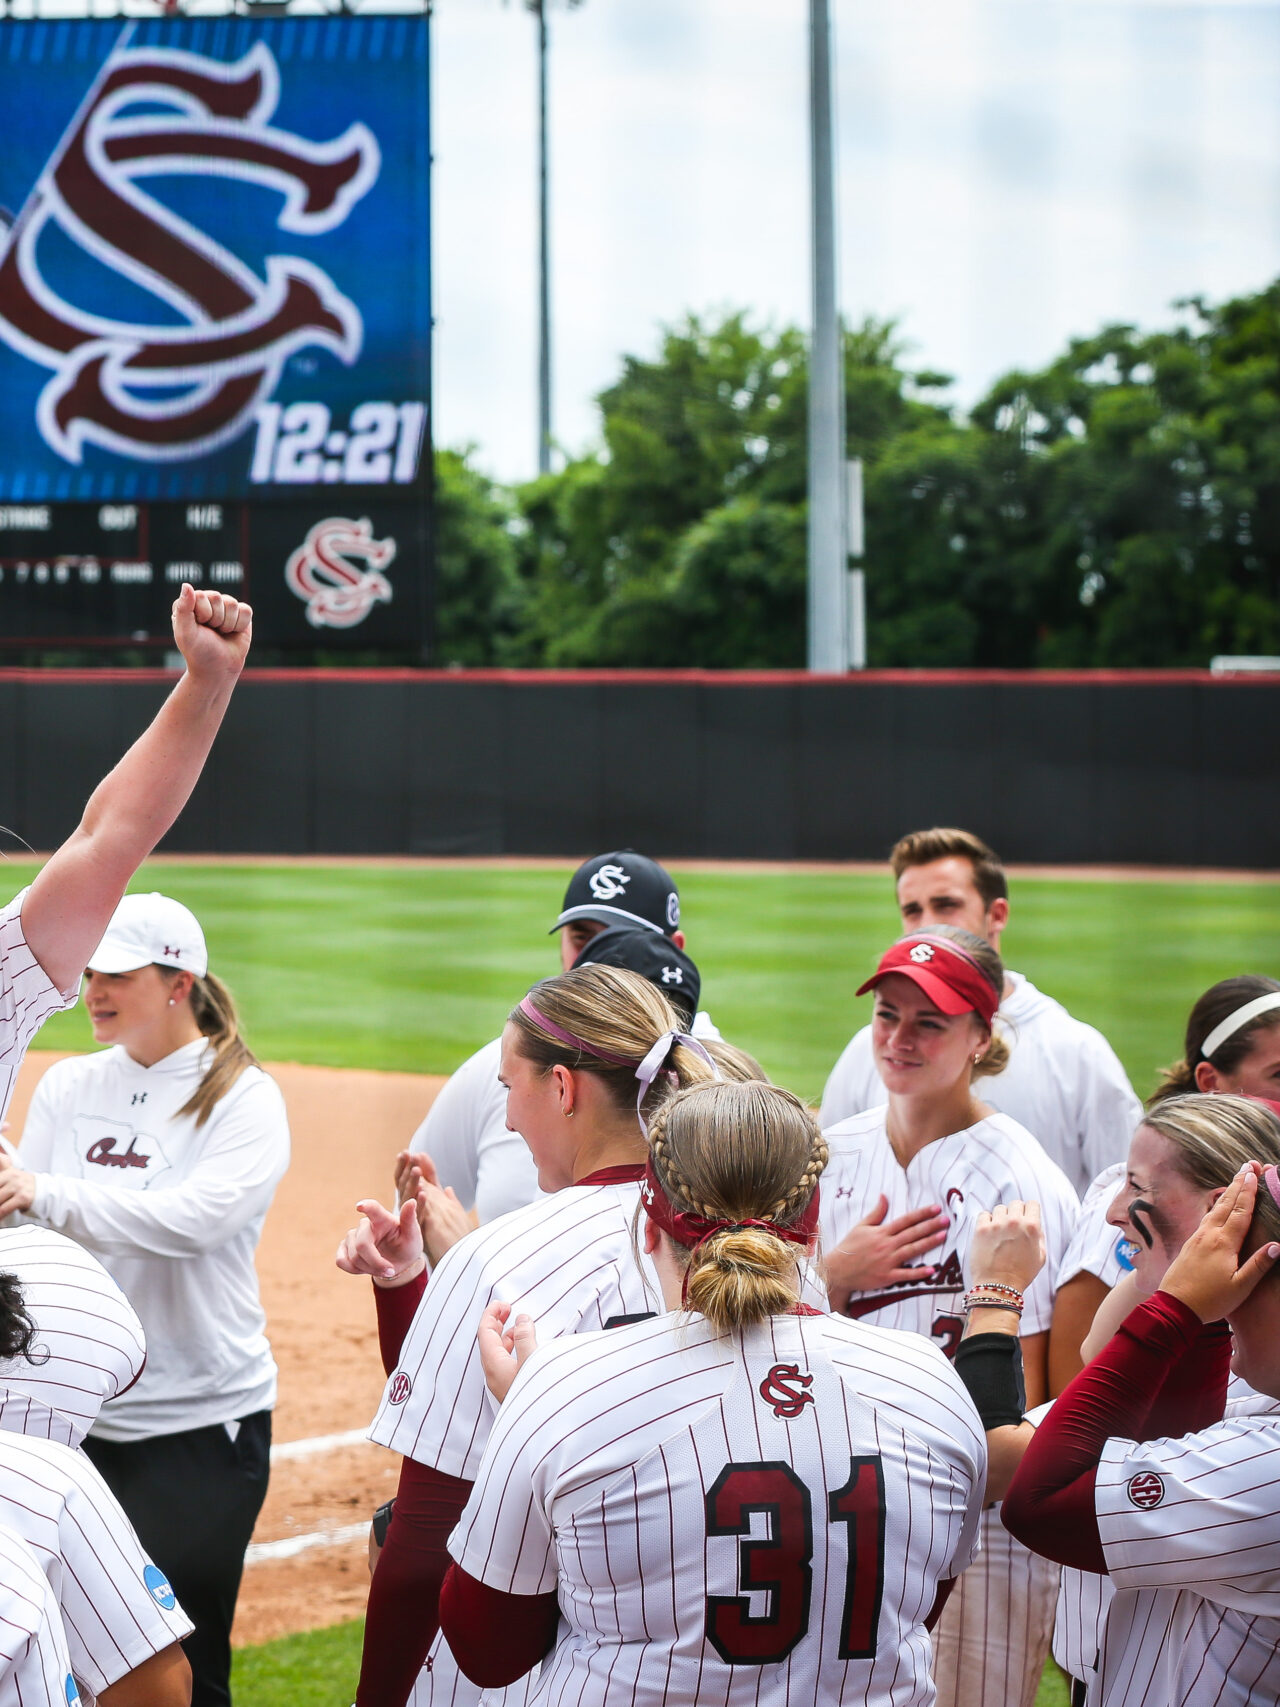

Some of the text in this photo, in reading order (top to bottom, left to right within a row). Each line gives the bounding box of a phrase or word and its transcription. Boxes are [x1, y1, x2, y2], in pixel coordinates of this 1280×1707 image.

[250, 401, 427, 484] 12:21
[390, 1374, 409, 1402] SEC
[1129, 1473, 1162, 1506] SEC
[704, 1454, 887, 1665] 31
